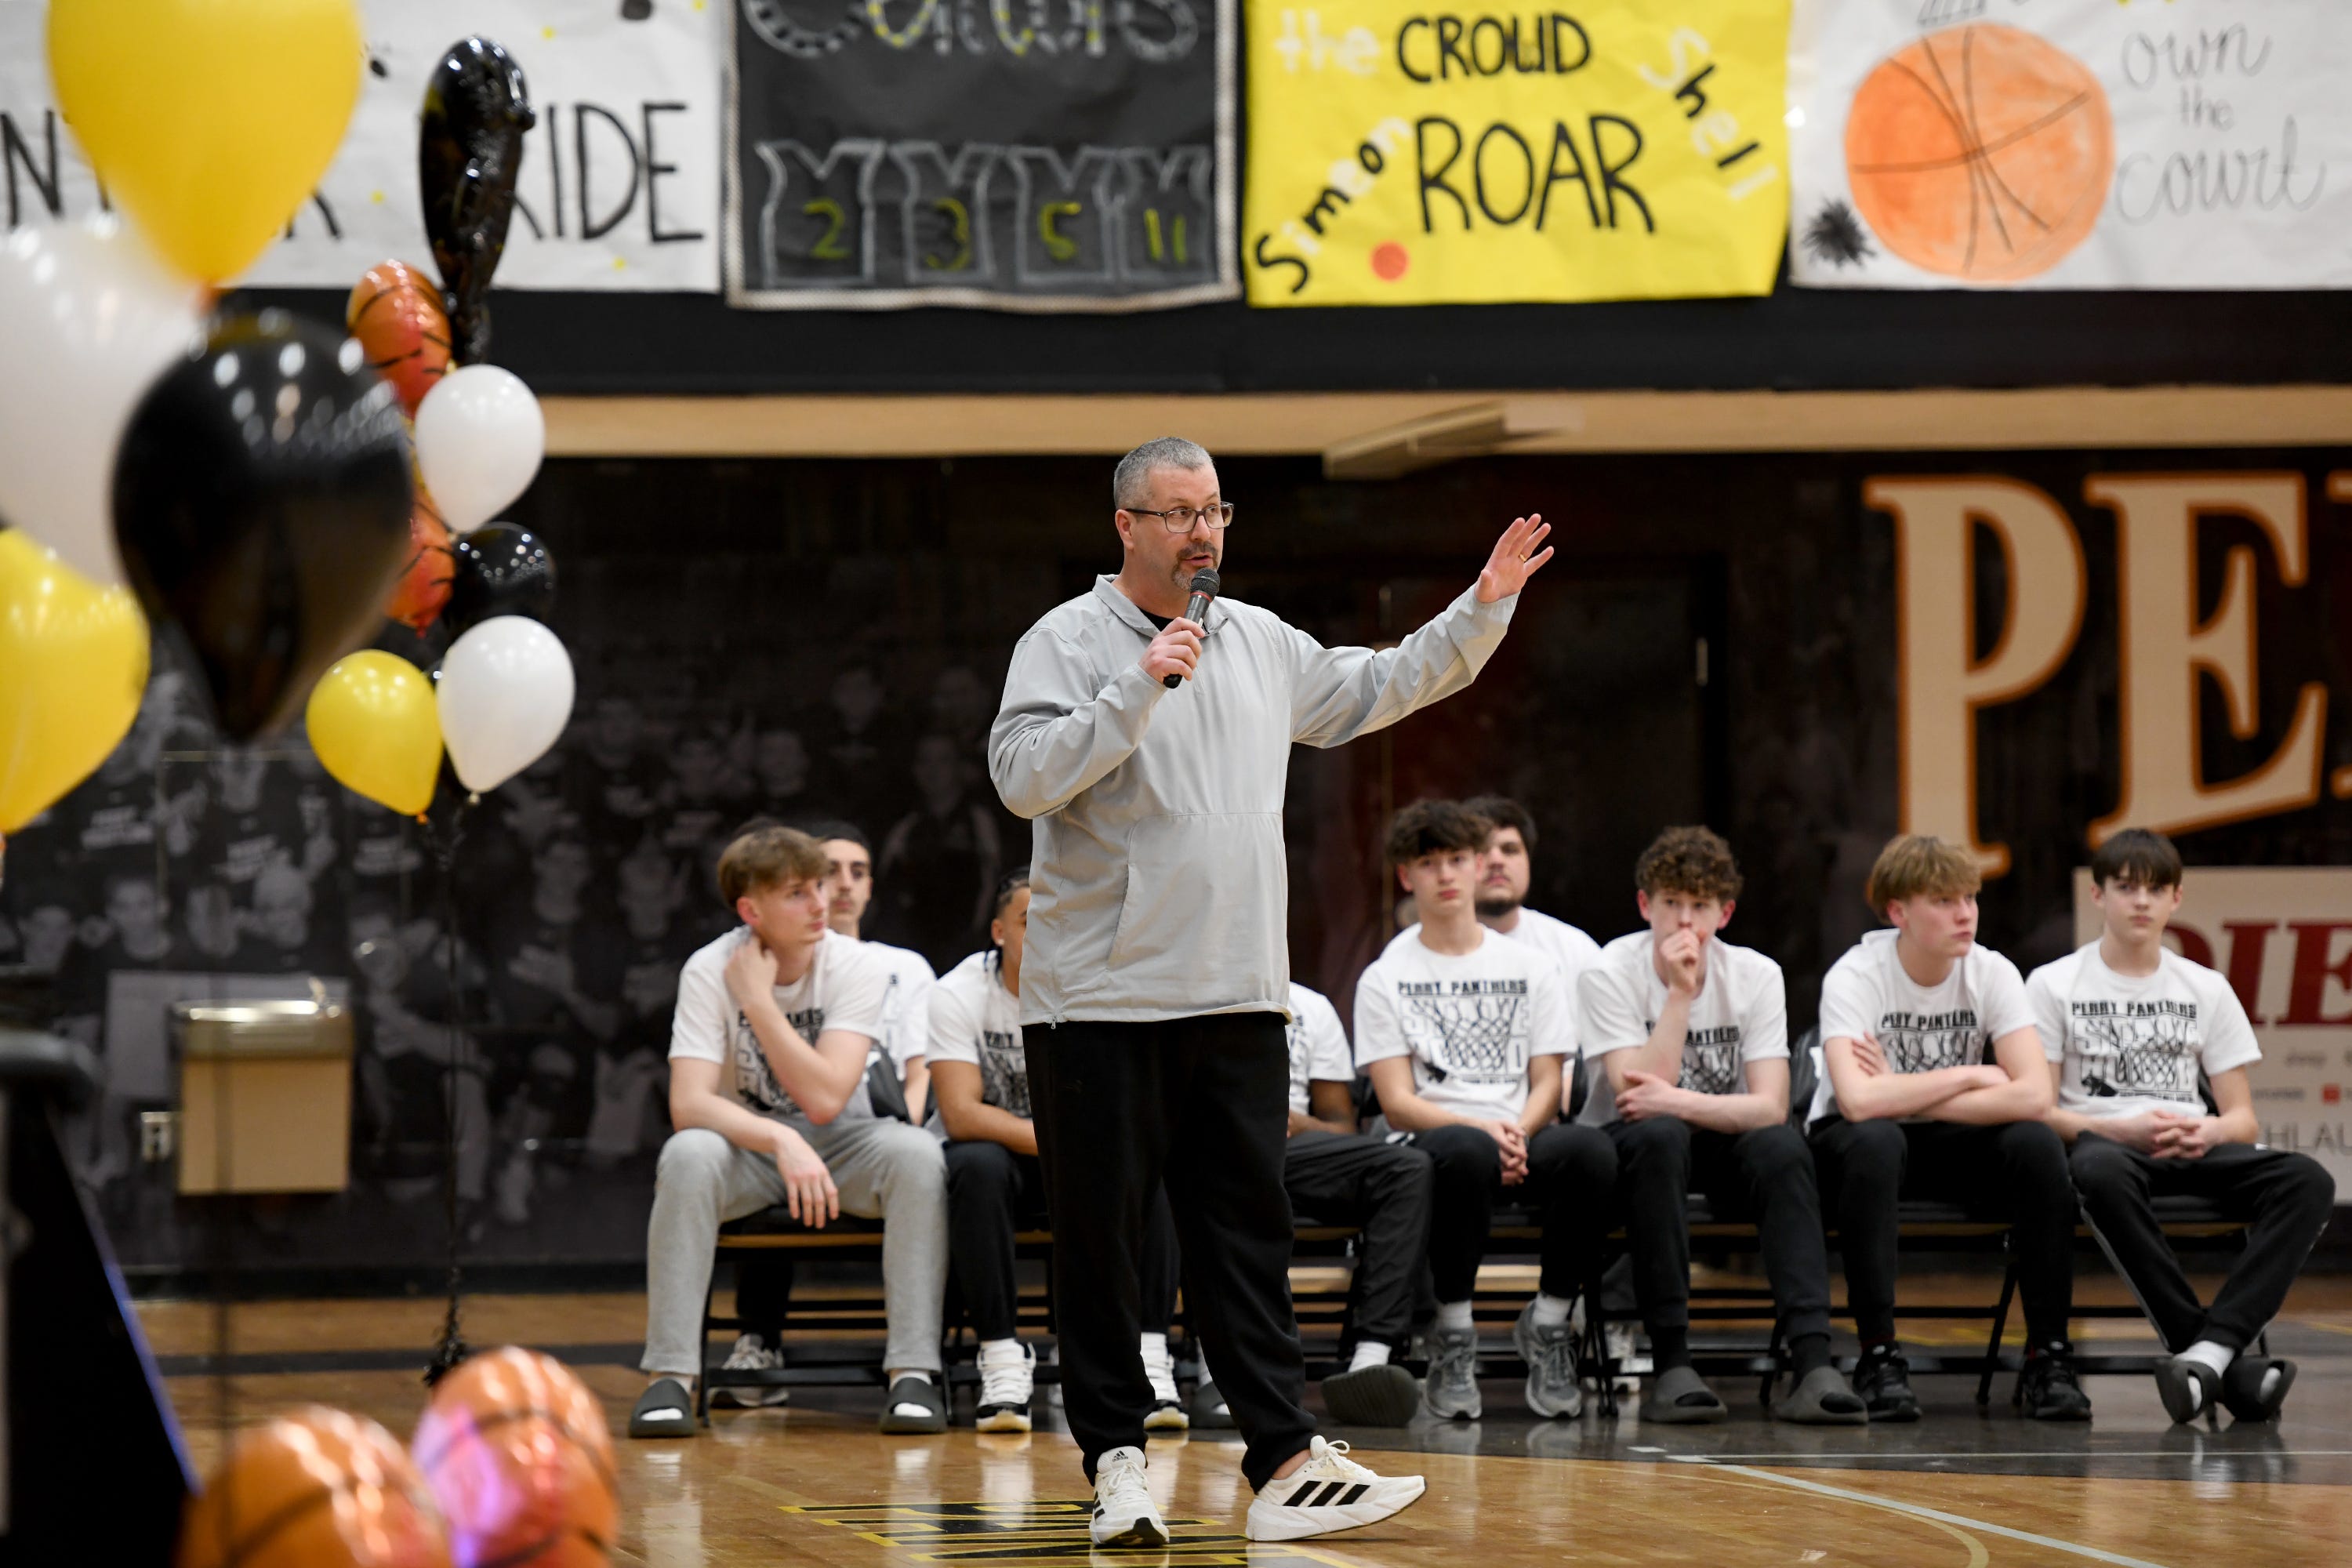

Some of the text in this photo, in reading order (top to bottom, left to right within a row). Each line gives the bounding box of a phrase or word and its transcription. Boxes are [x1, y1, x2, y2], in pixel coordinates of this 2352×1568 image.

[1273, 8, 1381, 74] the
[1396, 13, 1591, 84] CROWD
[2121, 22, 2273, 89] own
[2179, 85, 2234, 131] the
[506, 103, 704, 242] IDE
[1416, 113, 1656, 234] ROAR
[2118, 114, 2327, 227] court
[802, 198, 849, 260] 2
[925, 197, 971, 271] 3
[1144, 207, 1186, 265] 11
[1861, 469, 2352, 909] PE
